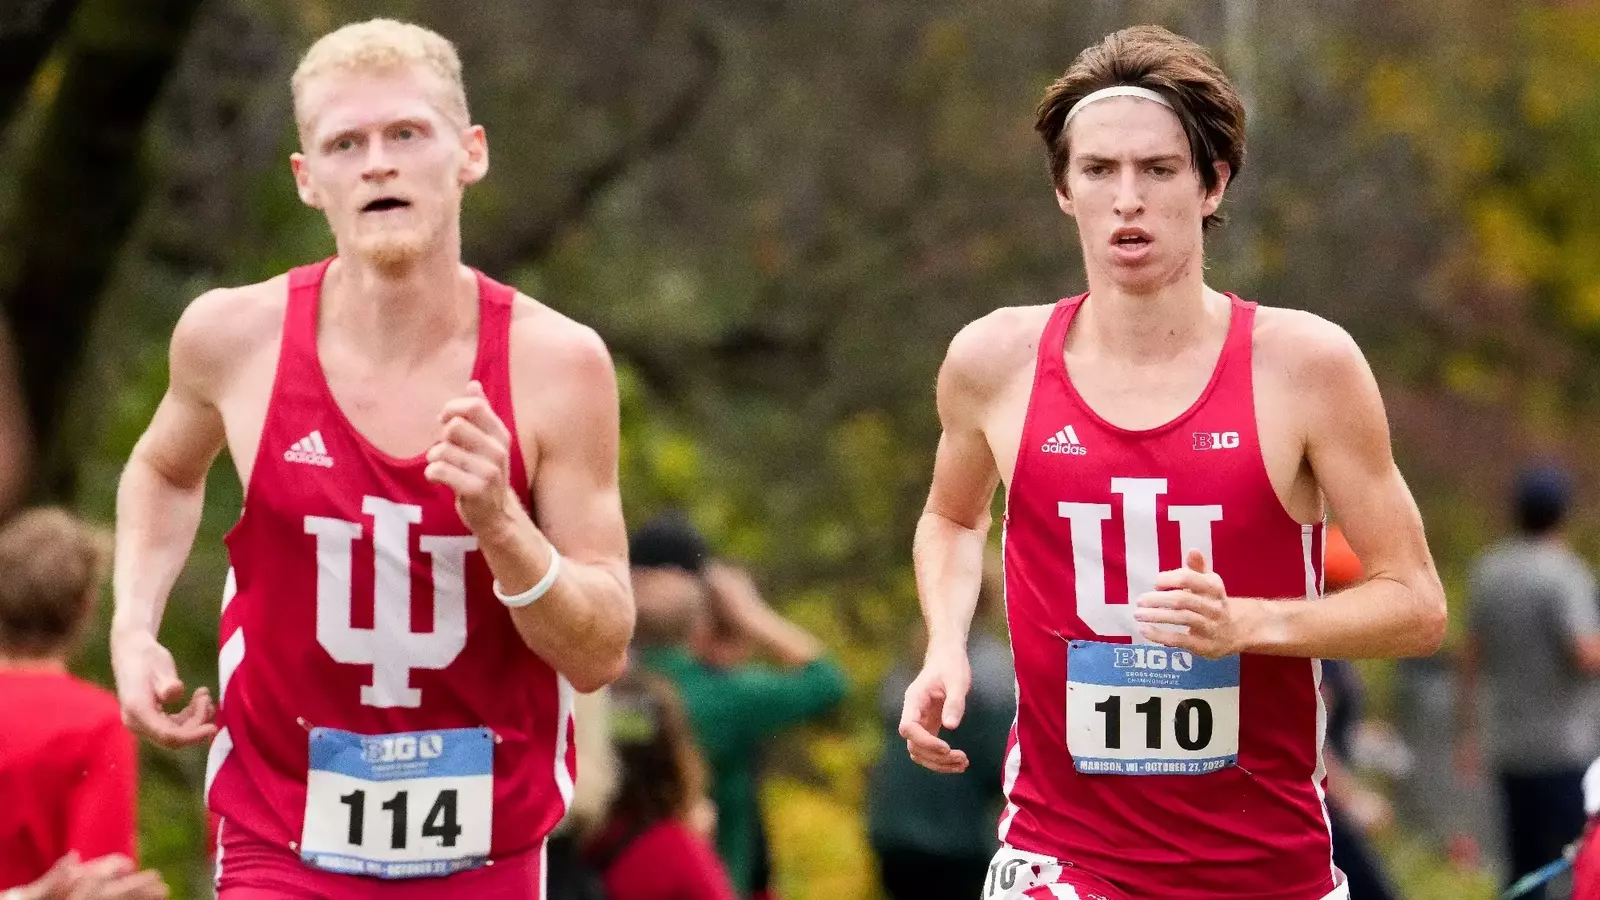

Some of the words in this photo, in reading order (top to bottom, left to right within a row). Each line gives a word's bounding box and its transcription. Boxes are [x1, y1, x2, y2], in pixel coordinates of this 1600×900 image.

[1041, 442, 1088, 456] adidas
[283, 449, 335, 469] adidas
[1149, 672, 1181, 680] COUNTRY
[1094, 694, 1214, 752] 110
[1125, 762, 1139, 772] WI
[1145, 761, 1187, 773] OCTOBER
[1202, 759, 1226, 771] 2023
[340, 789, 463, 850] 114
